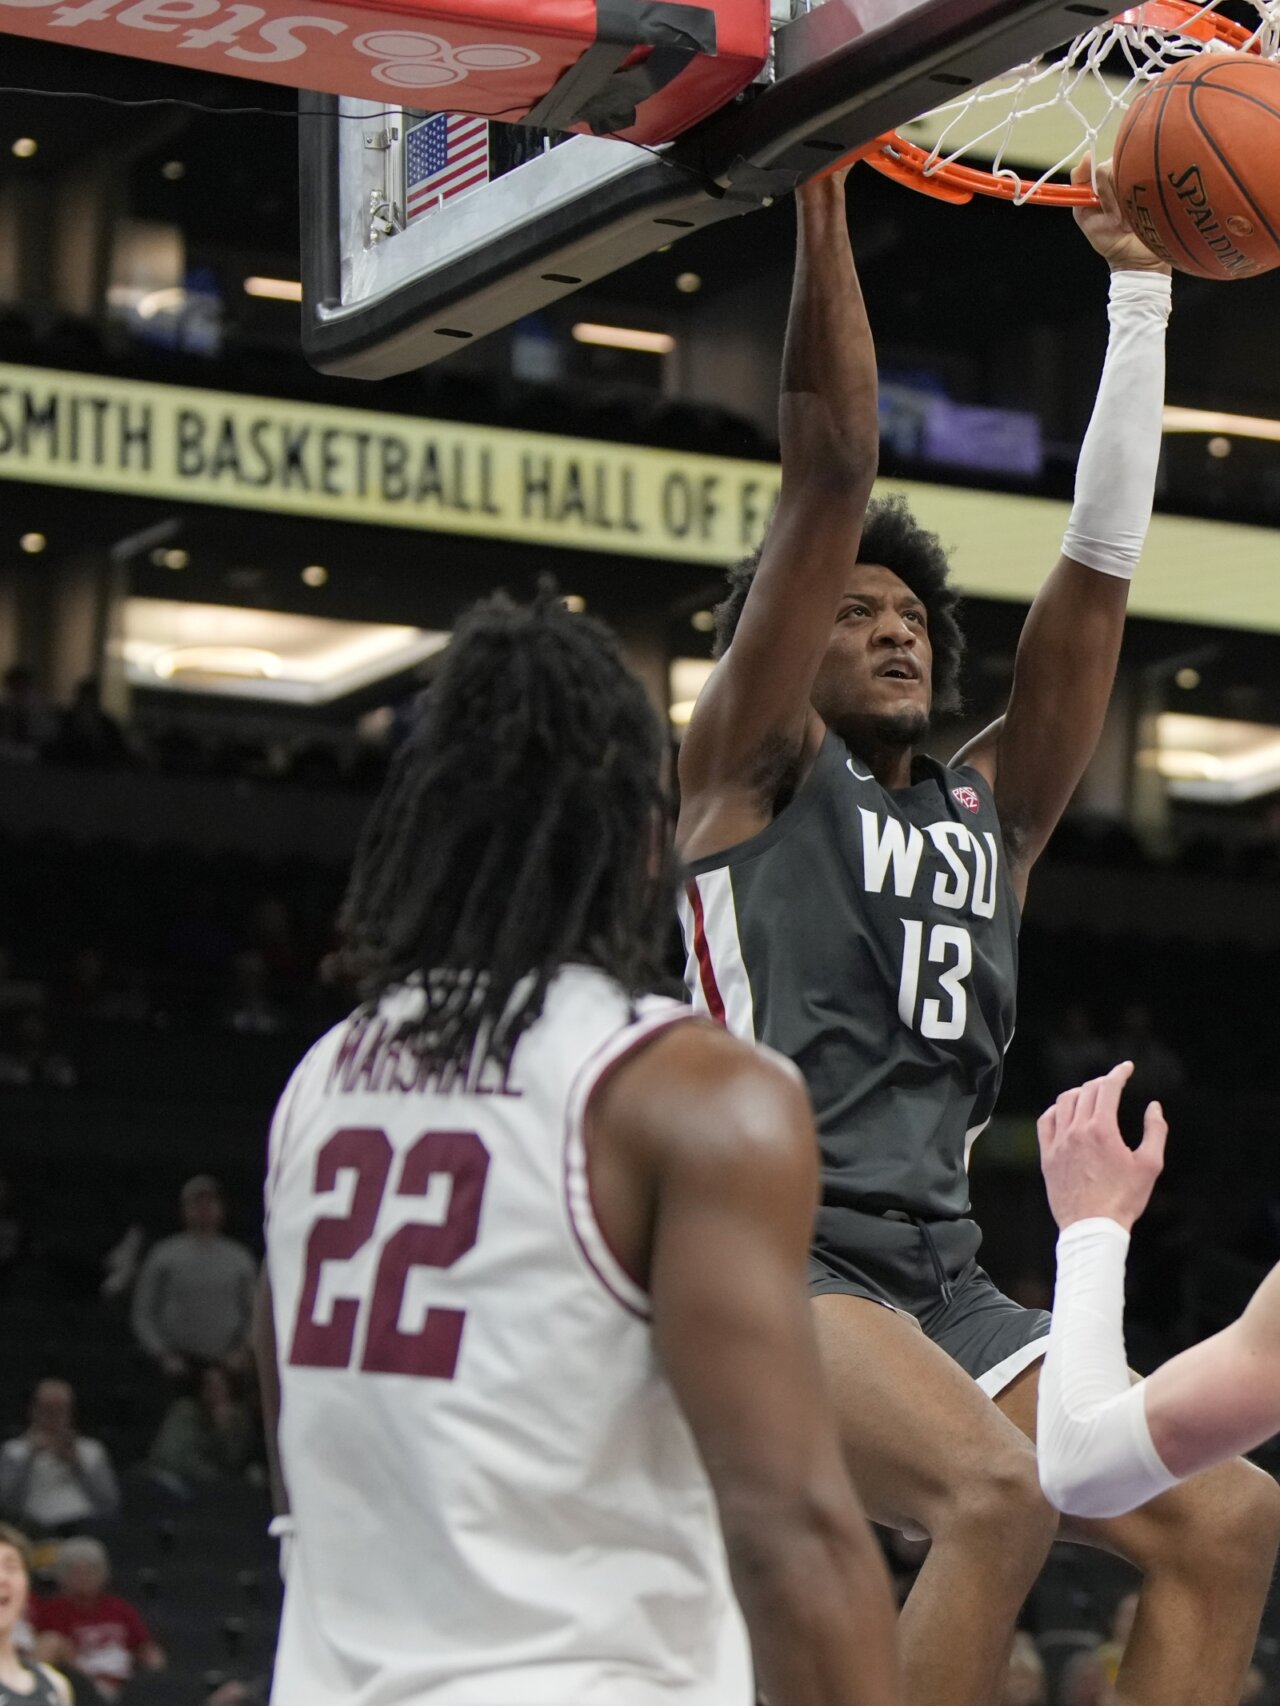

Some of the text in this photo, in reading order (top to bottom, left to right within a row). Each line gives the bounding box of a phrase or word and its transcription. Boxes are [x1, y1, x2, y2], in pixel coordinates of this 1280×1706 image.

[0, 0, 349, 63] Stat
[175, 408, 501, 515] BASKETBALL
[520, 448, 641, 534] HALL
[662, 469, 719, 540] OF
[857, 805, 998, 919] WSU
[898, 918, 972, 1040] 13
[289, 1128, 491, 1380] 22
